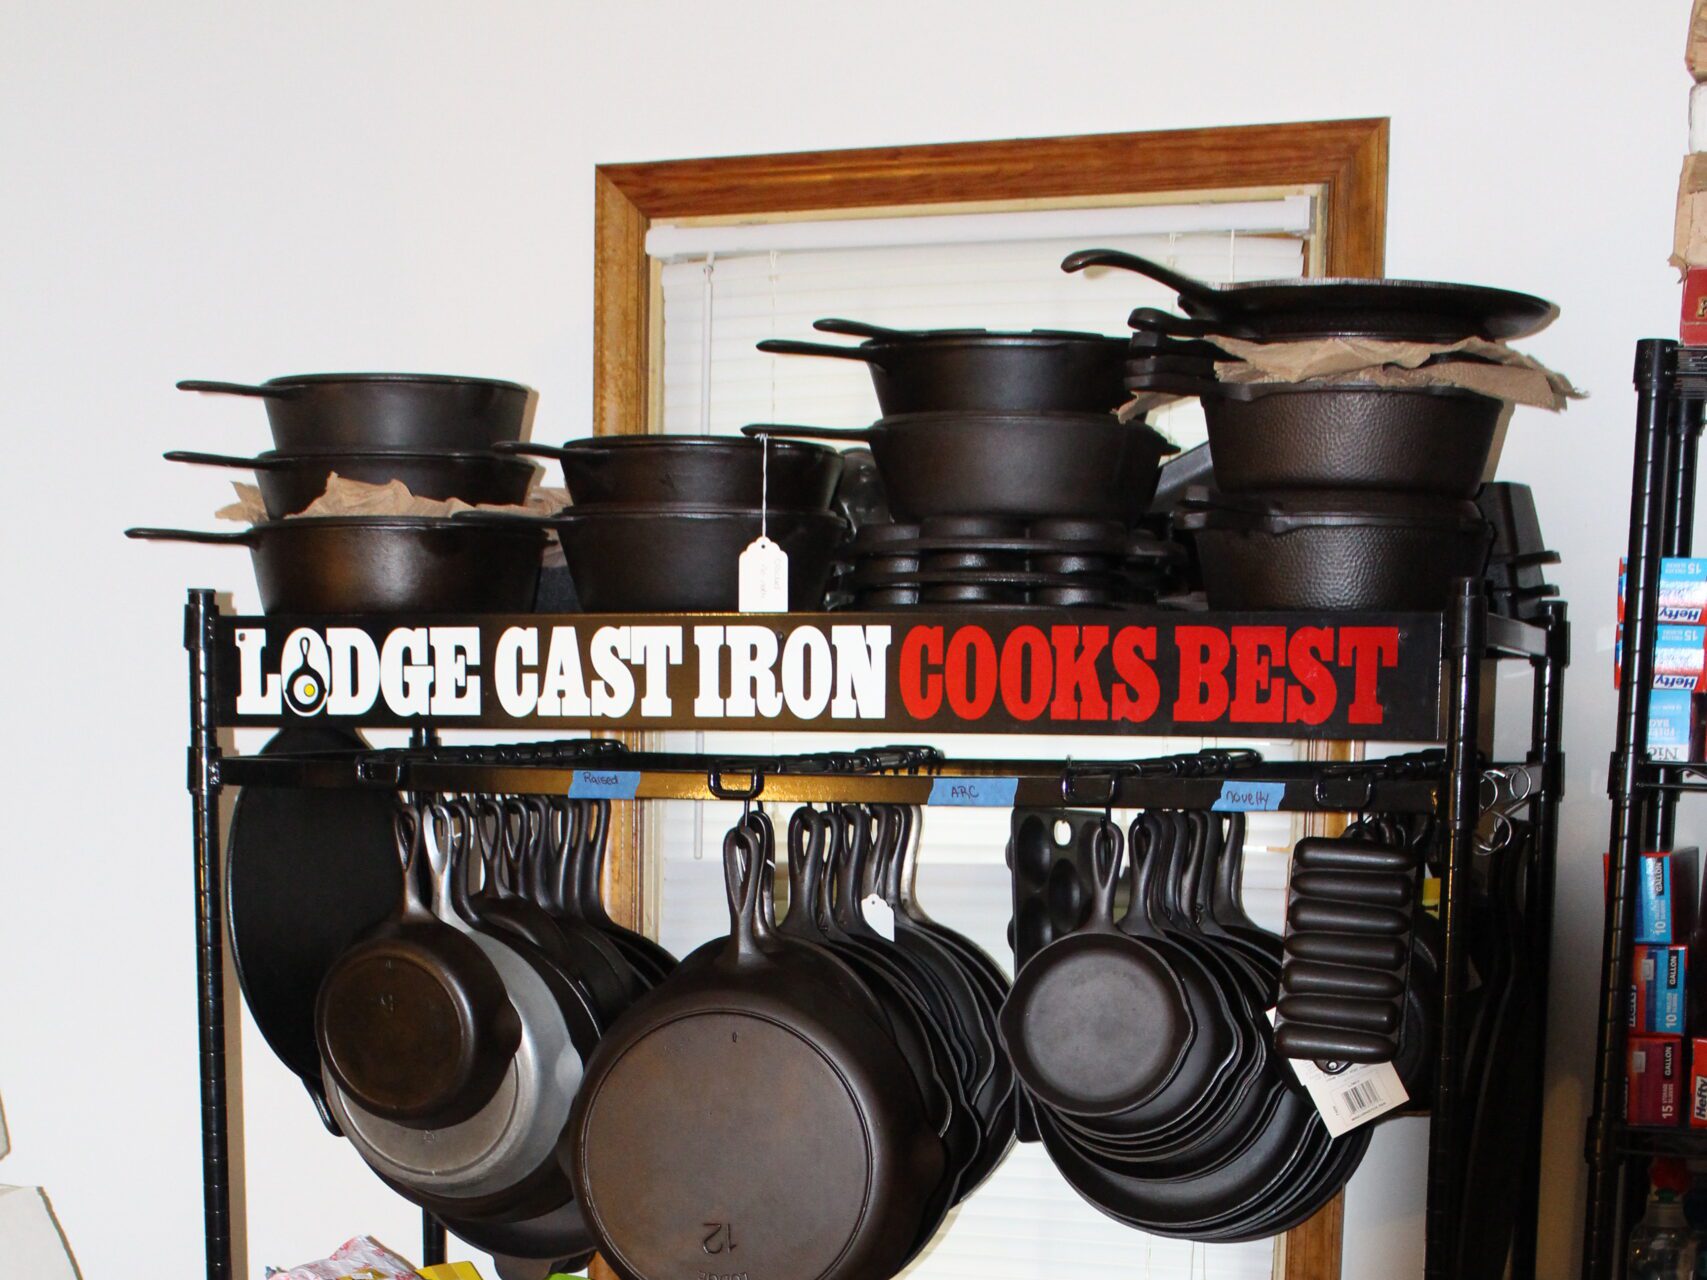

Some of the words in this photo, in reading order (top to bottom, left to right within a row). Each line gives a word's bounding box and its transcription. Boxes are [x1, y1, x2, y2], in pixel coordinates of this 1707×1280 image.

[1659, 606, 1699, 620] Hefty
[235, 626, 480, 716] LODGE
[495, 625, 682, 718] CAST
[694, 624, 892, 719] IRON
[900, 624, 1160, 722] COOKS
[1173, 625, 1399, 724] BEST
[1655, 674, 1696, 688] Hefty
[582, 771, 619, 785] Raised
[951, 785, 979, 799] ARC
[1655, 862, 1663, 892] GALLON
[1655, 921, 1666, 935] 10
[1669, 955, 1677, 985] GALLON
[1666, 1014, 1677, 1028] 10
[1664, 1046, 1672, 1076] GALLON
[1695, 1079, 1707, 1118] Hefty
[1662, 1105, 1673, 1118] 15
[703, 1223, 737, 1254] 12
